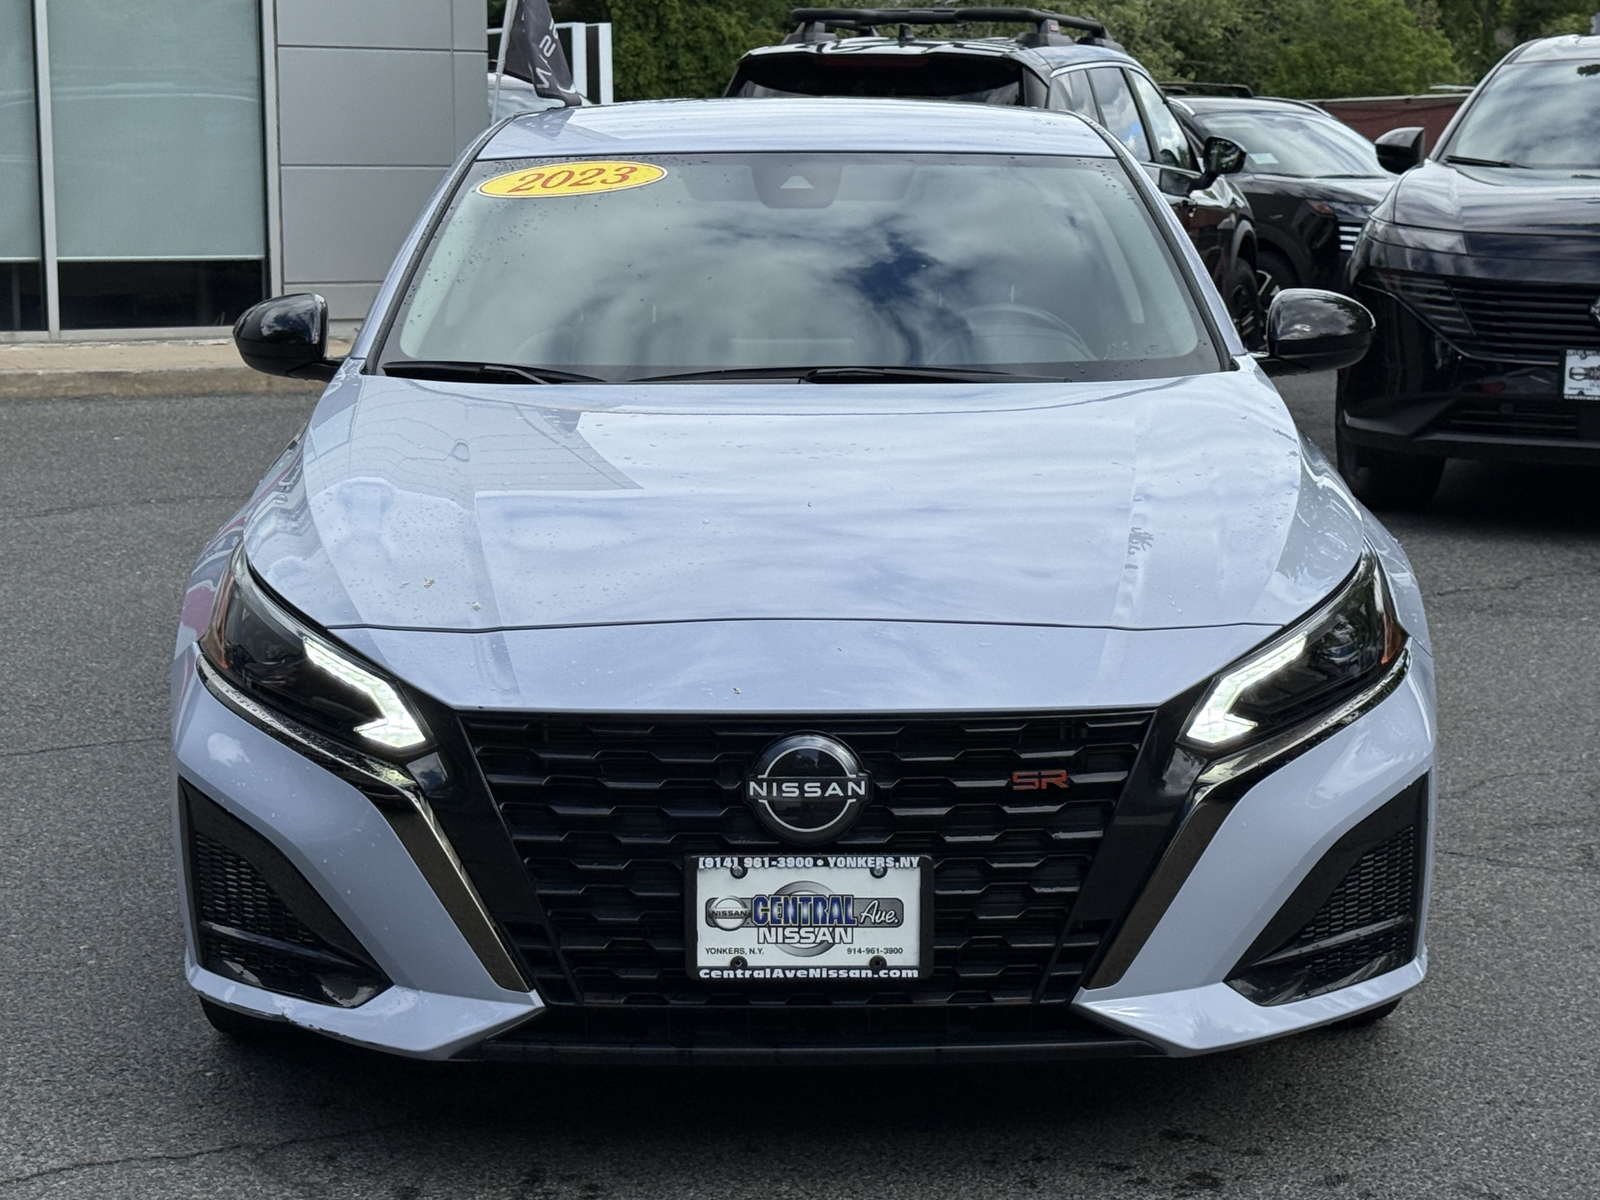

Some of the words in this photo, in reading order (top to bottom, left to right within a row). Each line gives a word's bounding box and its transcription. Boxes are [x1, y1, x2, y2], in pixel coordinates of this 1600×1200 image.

[506, 166, 638, 193] 2023
[1012, 769, 1069, 791] SR
[749, 780, 867, 798] NISSAN
[743, 857, 814, 868] 961-3900
[711, 909, 748, 918] NISSAN
[752, 894, 857, 926] CENTRAL
[860, 900, 900, 924] Ave.
[757, 926, 854, 944] NISSAN
[705, 946, 748, 956] YONKERS,
[749, 947, 765, 955] N.Y.
[846, 946, 904, 955] 914-961-3900
[698, 967, 919, 979] CentralAveNissan.com
